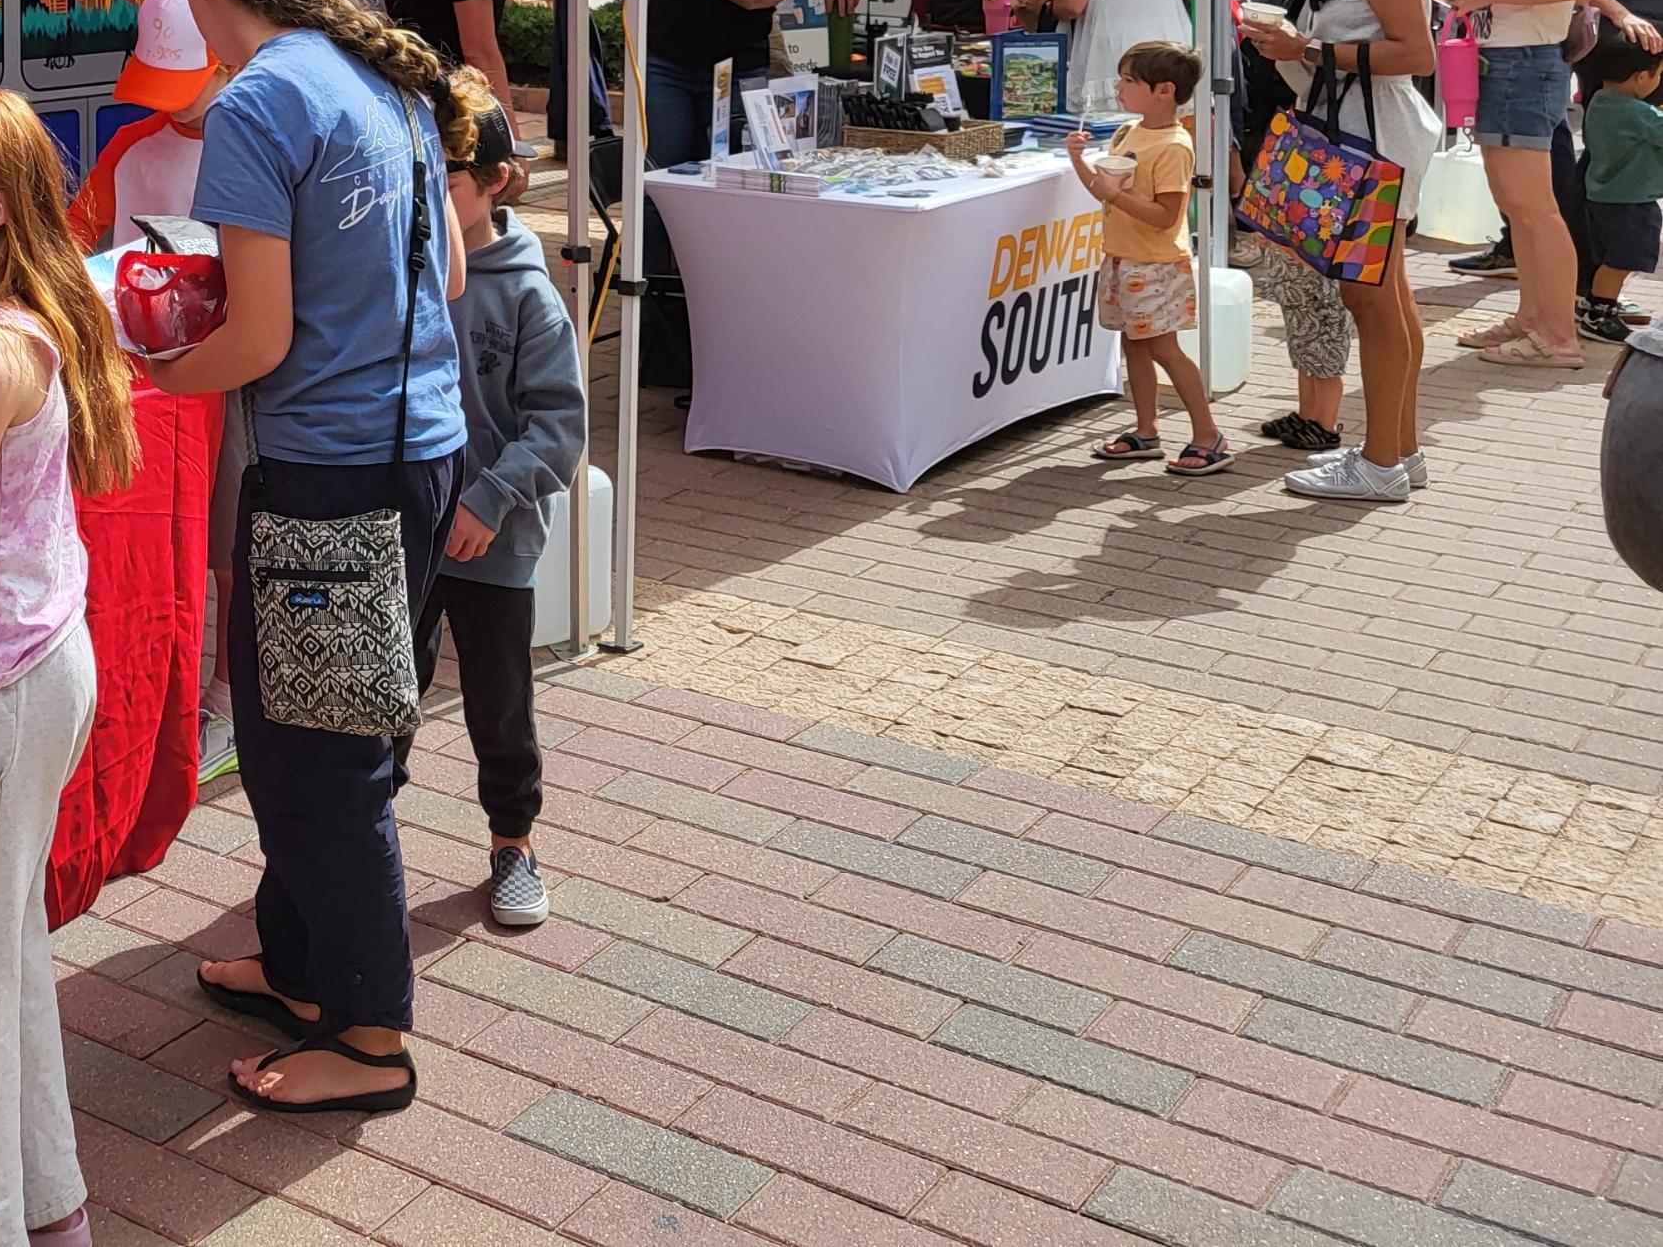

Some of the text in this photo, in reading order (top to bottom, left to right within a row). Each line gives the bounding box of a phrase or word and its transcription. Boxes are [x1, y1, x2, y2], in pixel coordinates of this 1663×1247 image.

[788, 43, 799, 55] to
[794, 59, 817, 72] eeds
[987, 209, 1104, 301] DENVER
[971, 270, 1100, 400] SOUTH
